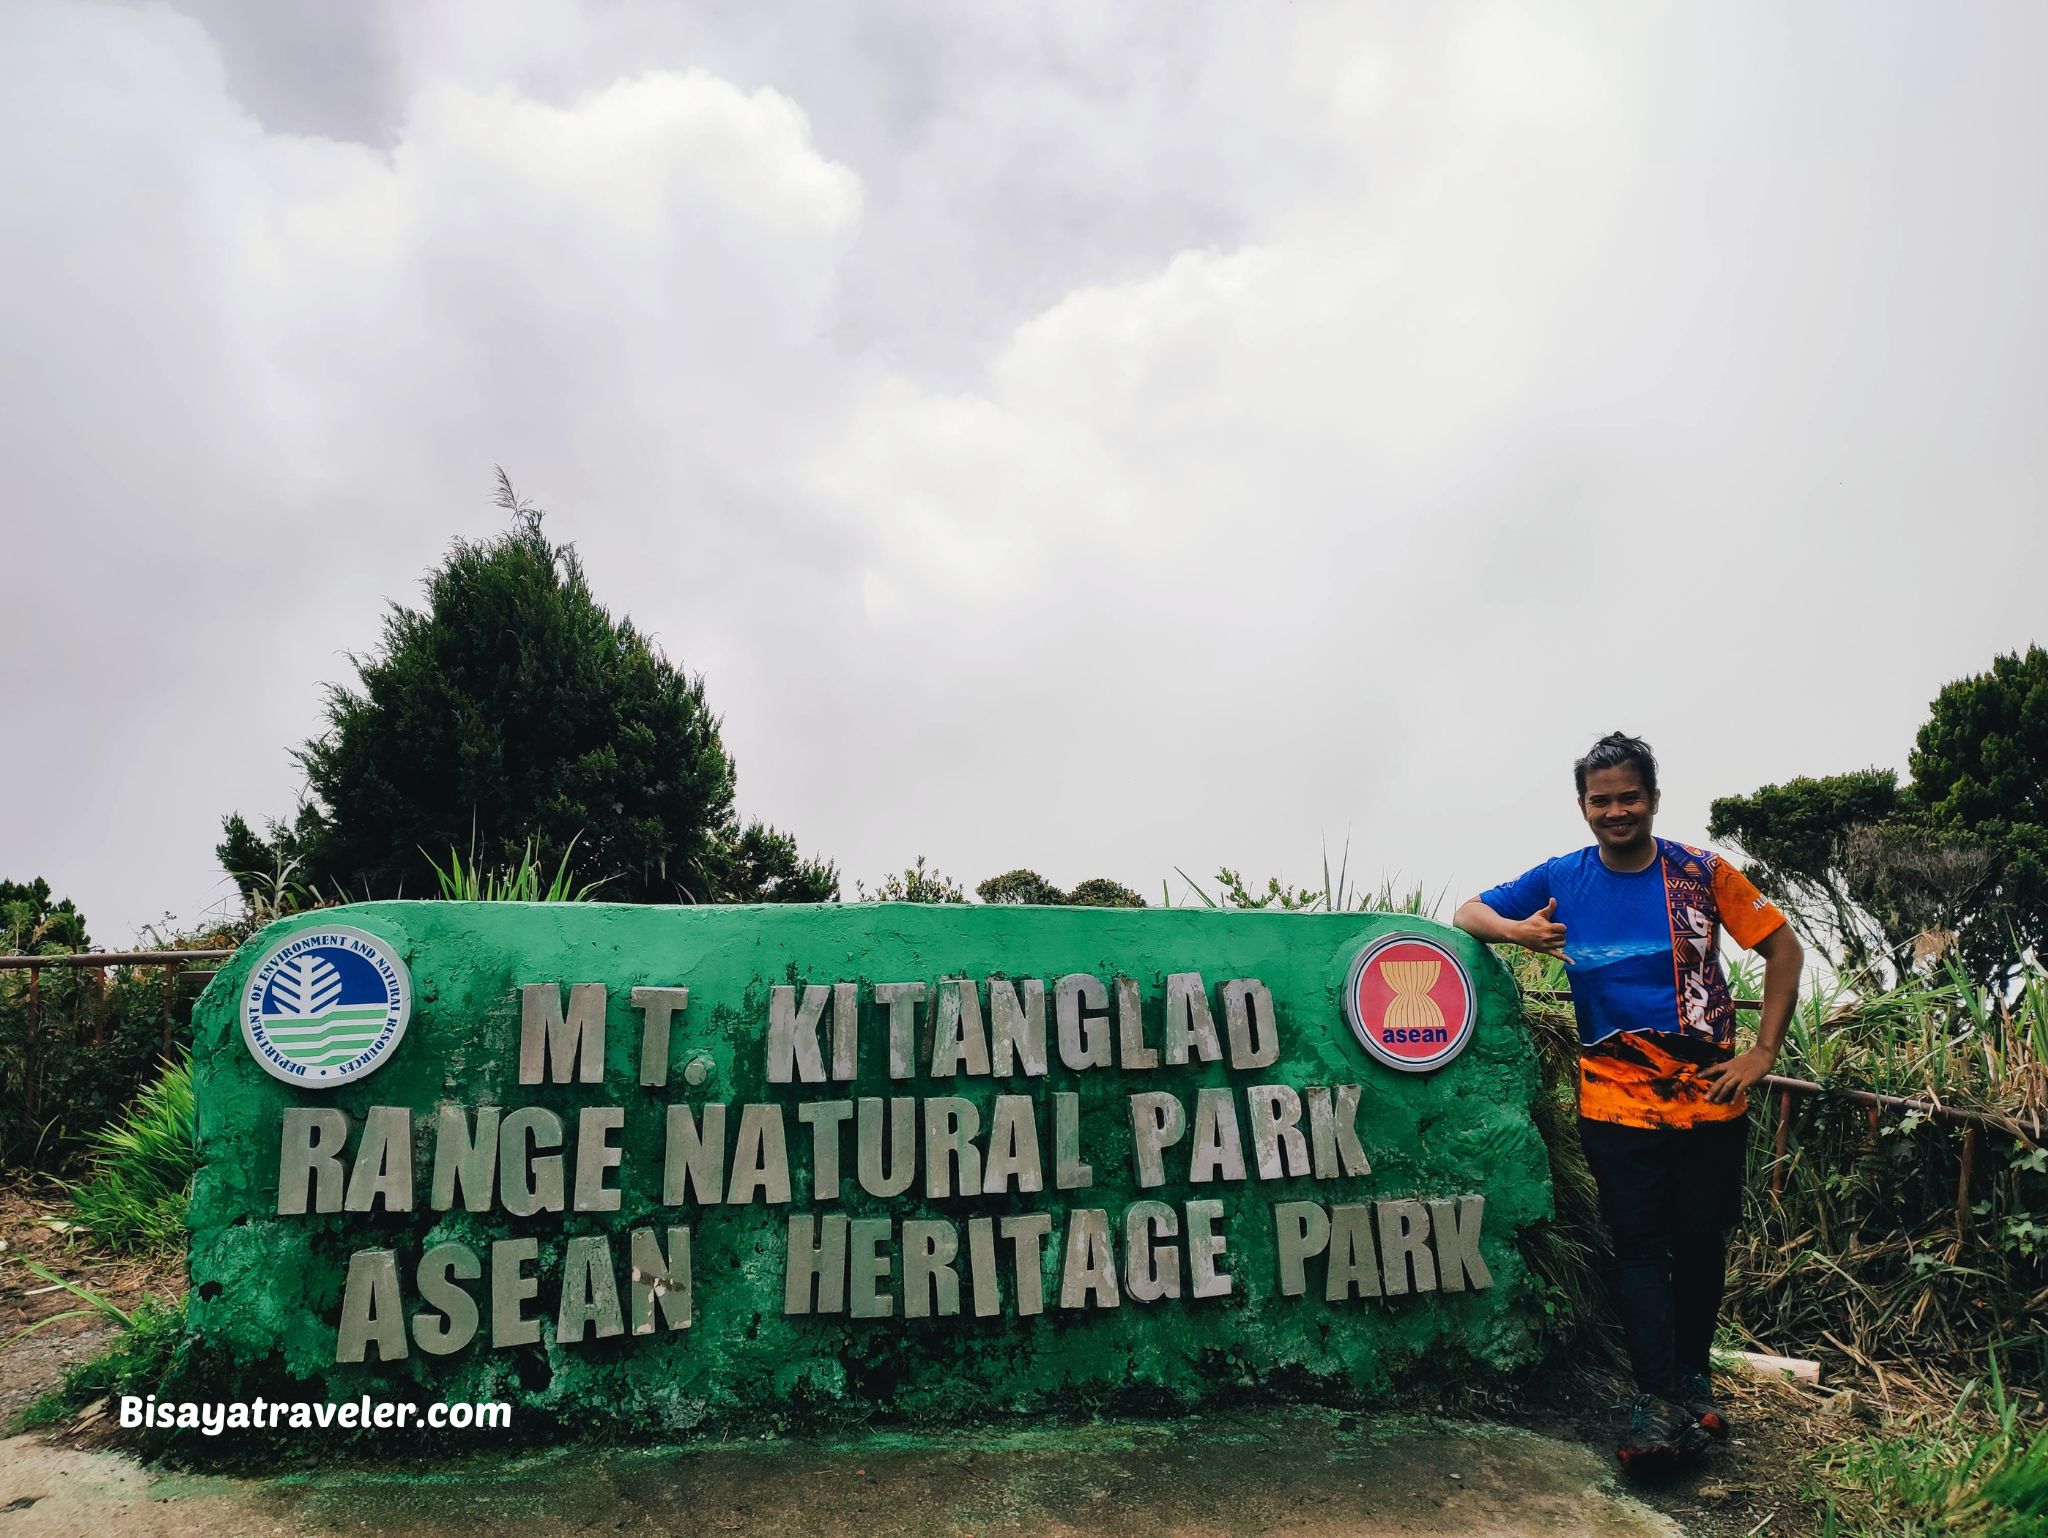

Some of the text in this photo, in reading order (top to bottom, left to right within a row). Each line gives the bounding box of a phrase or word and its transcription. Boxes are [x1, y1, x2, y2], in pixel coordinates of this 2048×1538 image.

[248, 935, 401, 1076] DEPARTMENT OF ENVIRONMENT AND NATURAL RESOURCES
[519, 972, 1280, 1087] MT. KITANGLAD
[1382, 1027, 1448, 1044] asean
[1684, 973, 1697, 1024] MOUNT
[1686, 905, 1714, 1036] PULAG
[277, 1083, 1372, 1217] RANGE NATURAL PARK
[335, 1194, 1495, 1363] ASEAN HERITAGE PARK
